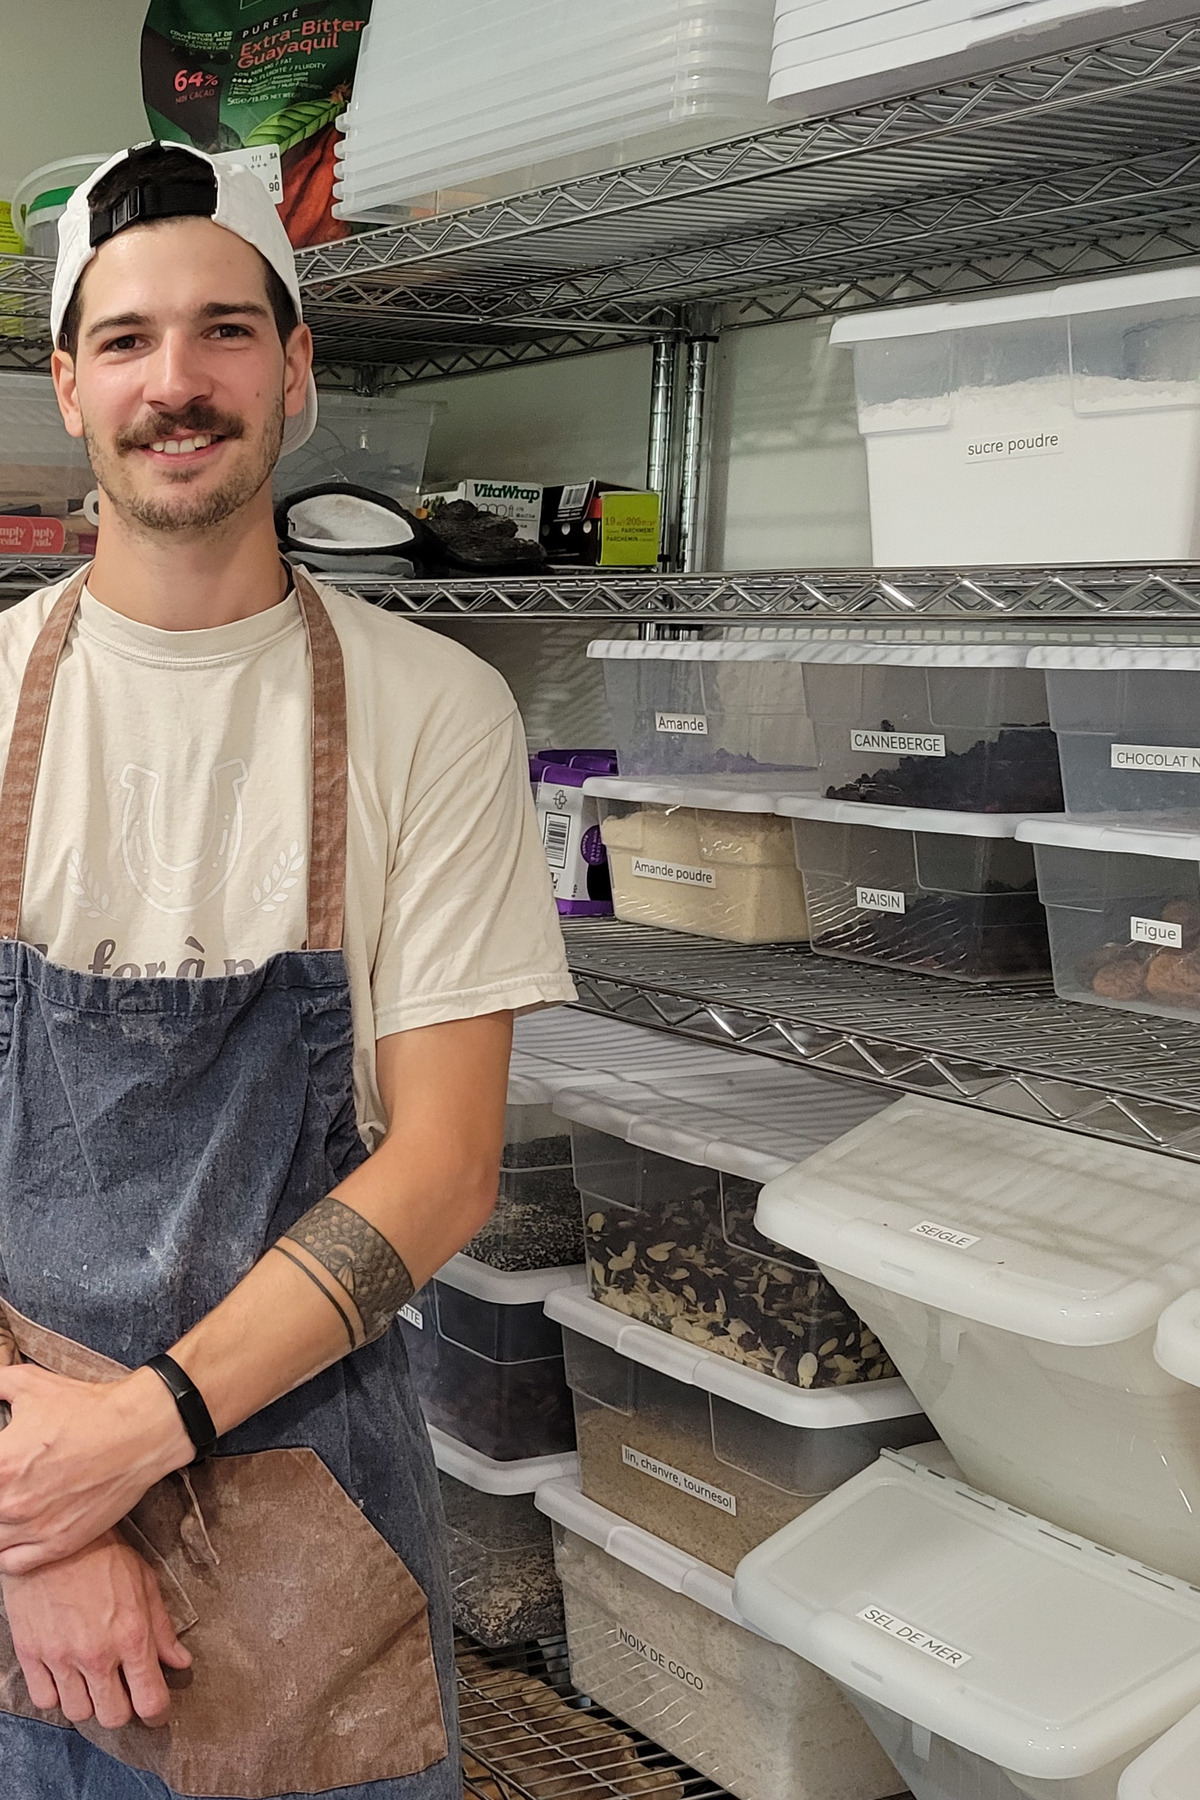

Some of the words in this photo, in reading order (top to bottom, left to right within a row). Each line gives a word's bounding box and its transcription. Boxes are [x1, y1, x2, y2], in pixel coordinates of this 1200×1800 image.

[242, 7, 300, 39] PURETÉ
[240, 18, 365, 57] Extra-Bitter
[236, 33, 339, 69] Guayaquil
[294, 62, 327, 71] FLUIDITY
[174, 69, 219, 92] 64%
[189, 88, 215, 100] CACAO
[268, 181, 281, 193] 90
[967, 441, 1004, 456] sucre
[1008, 433, 1059, 455] poudre
[473, 483, 540, 504] VitaWrap
[658, 715, 704, 732] Amande
[854, 733, 941, 752] CANNEBERGE
[1117, 752, 1188, 768] CHOCOLAT
[634, 860, 673, 877] Amande
[676, 868, 713, 884] poudre
[860, 891, 900, 909] RAISIN
[1136, 921, 1177, 941] Figue
[916, 1224, 971, 1246] SEIGLE
[625, 1448, 639, 1466] lin,
[640, 1458, 681, 1487] chanvre,
[683, 1476, 732, 1509] tournesol
[864, 1609, 894, 1631] SEL
[895, 1626, 925, 1644] DE
[921, 1639, 963, 1664] MER
[619, 1627, 648, 1657] NOIX
[650, 1647, 666, 1669] DE
[668, 1660, 704, 1691] COCO
